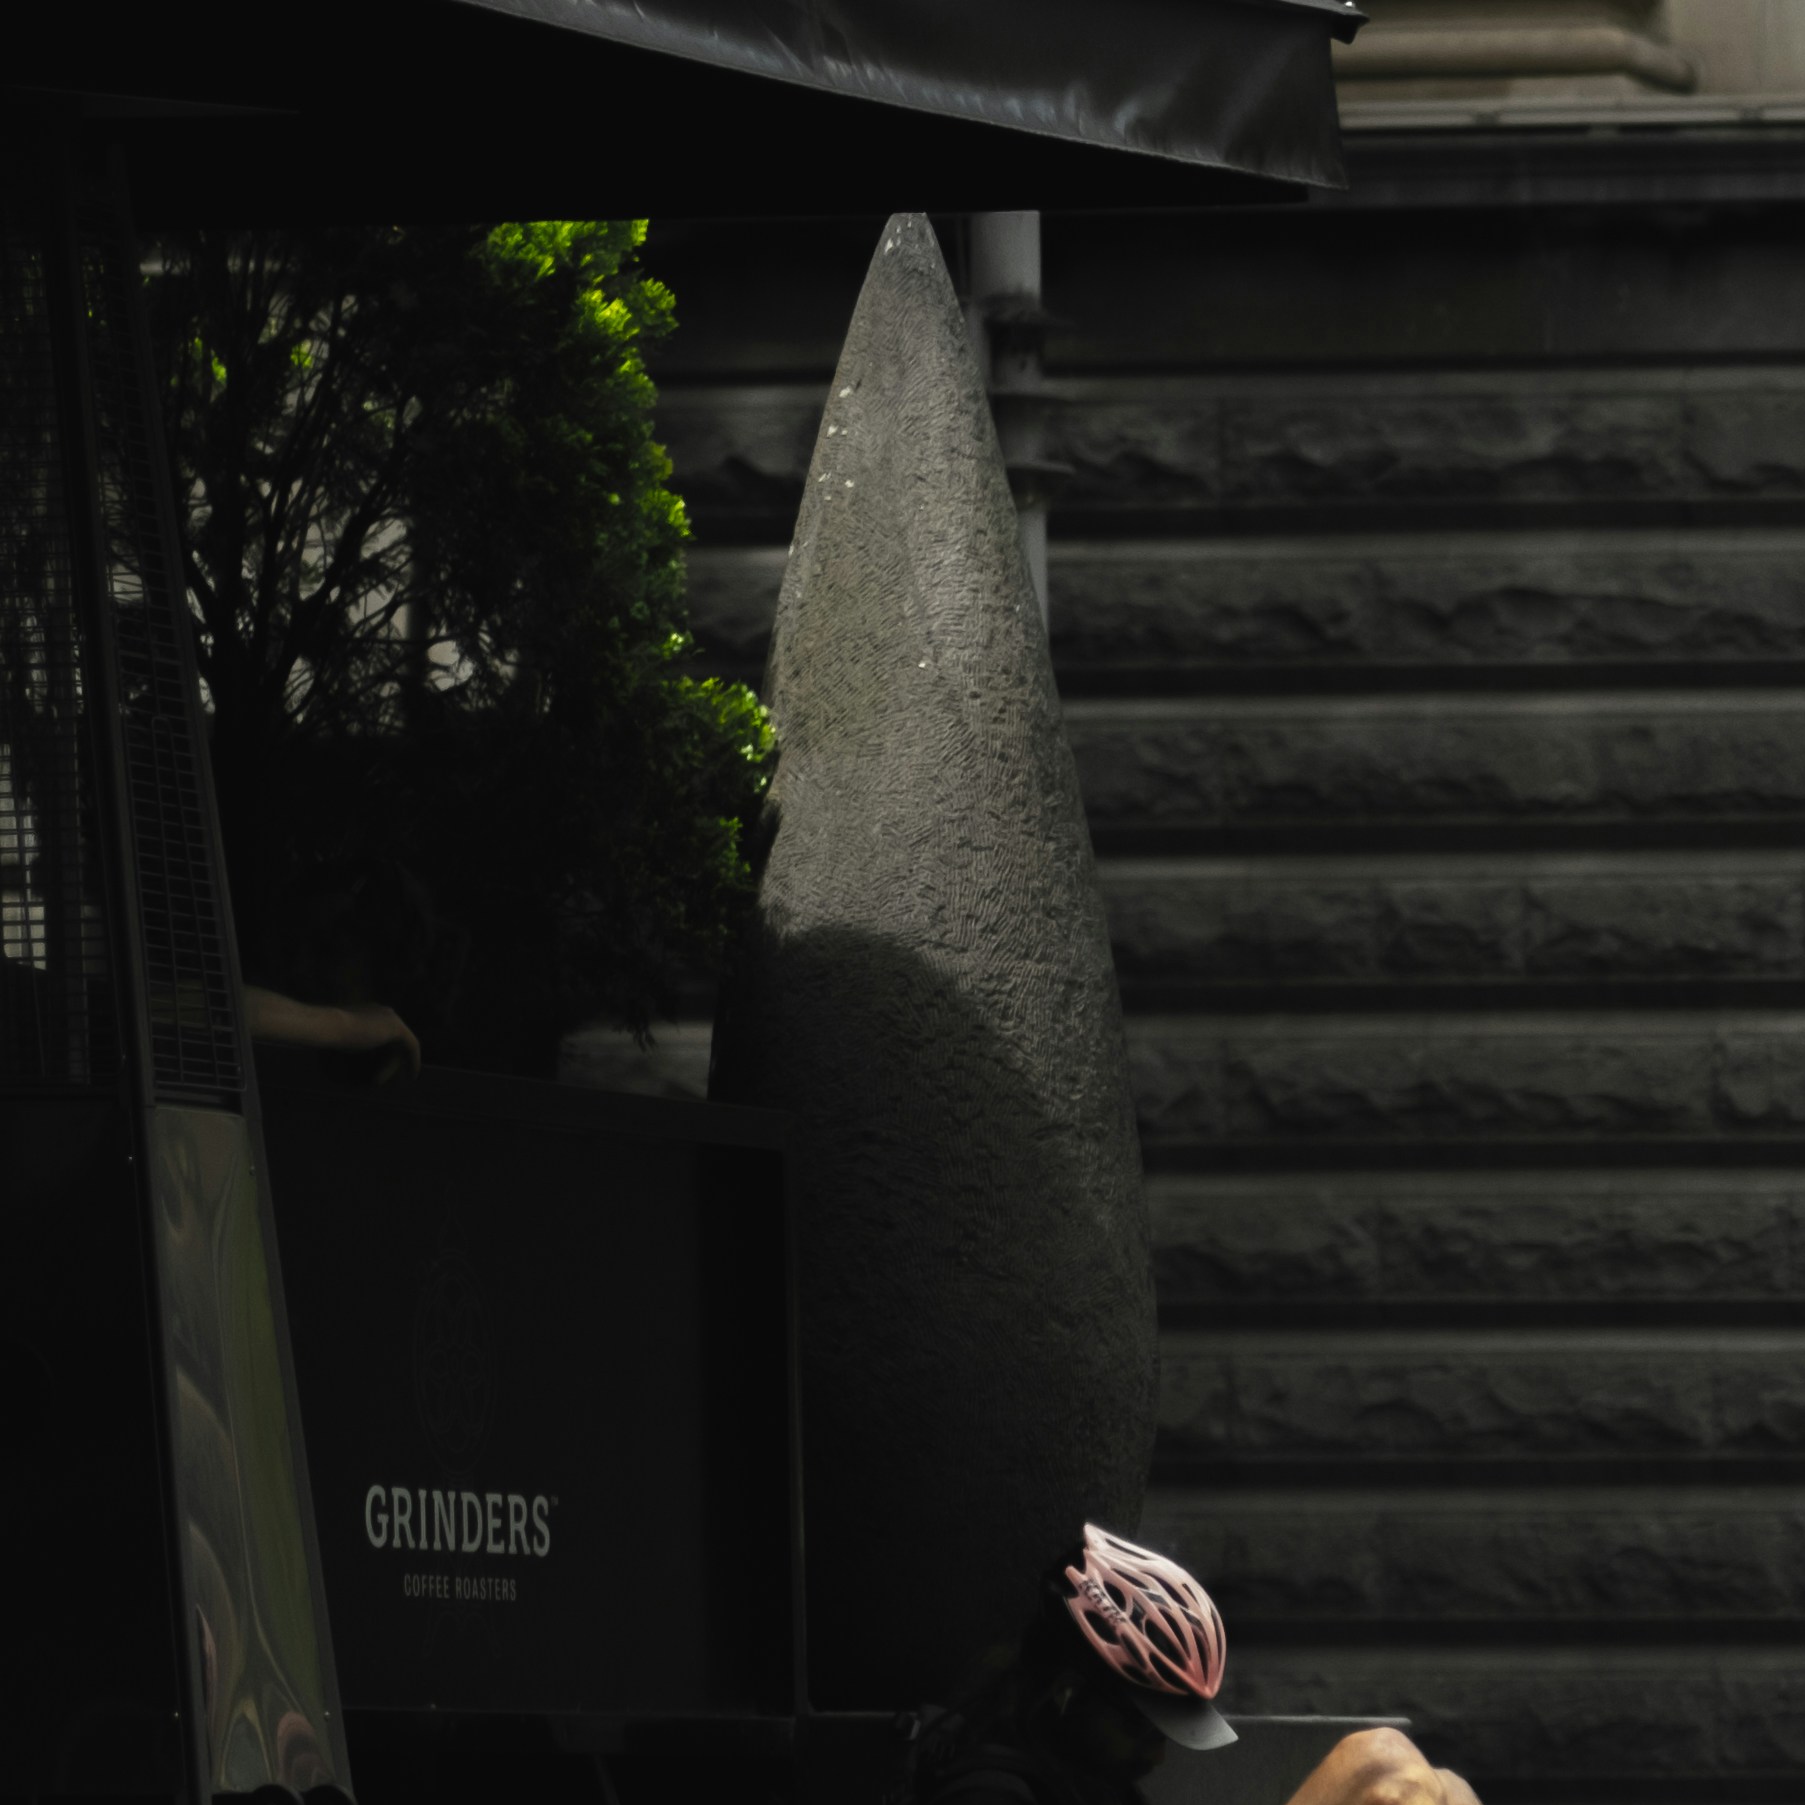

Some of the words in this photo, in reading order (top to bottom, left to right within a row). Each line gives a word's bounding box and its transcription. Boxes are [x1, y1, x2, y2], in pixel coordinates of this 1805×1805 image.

[364, 1484, 551, 1557] GRINDERS
[403, 1573, 451, 1599] COFFEE
[455, 1576, 517, 1601] ROASTERS
